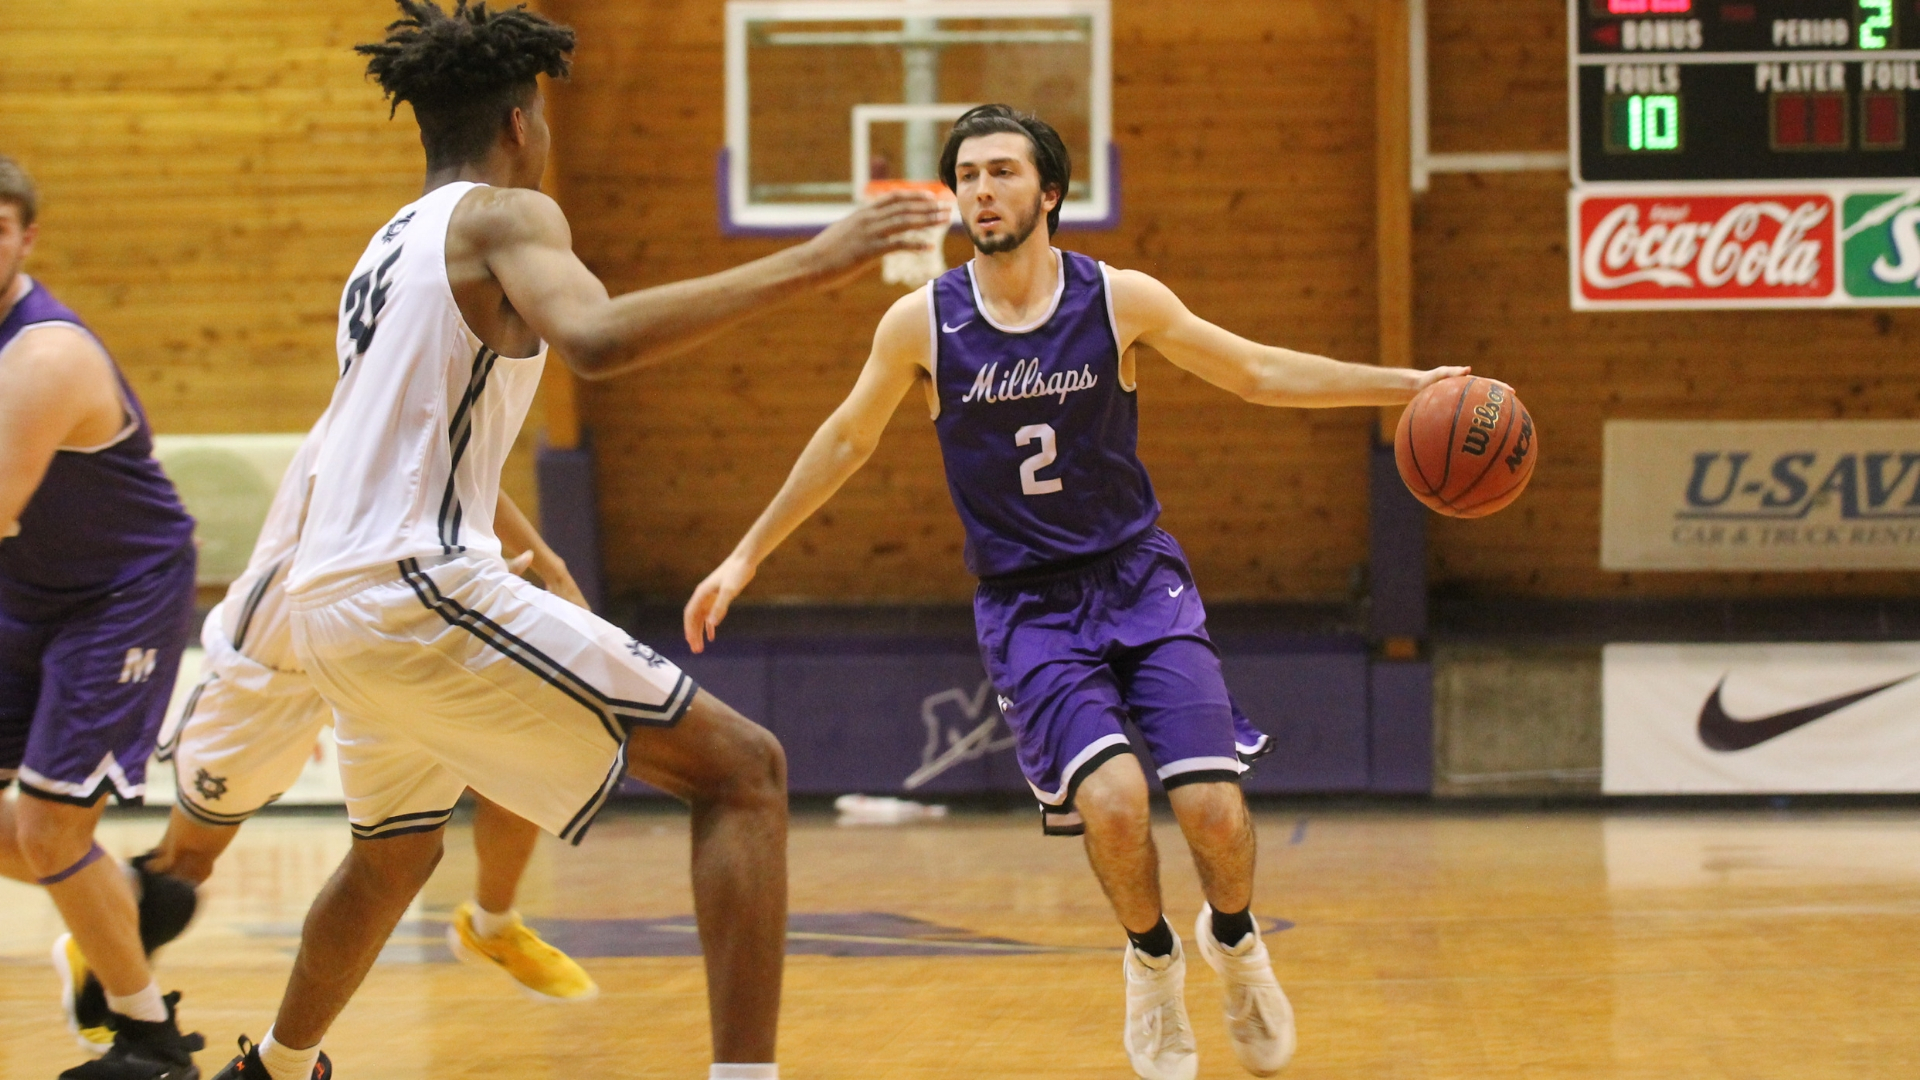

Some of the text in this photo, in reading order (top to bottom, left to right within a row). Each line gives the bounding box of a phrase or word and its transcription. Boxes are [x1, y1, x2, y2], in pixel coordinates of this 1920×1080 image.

[1622, 19, 1702, 49] BONUS
[1772, 0, 1892, 48] PERIOD 2
[1604, 63, 1680, 92] FOULS
[1756, 61, 1846, 92] PLAYER
[1628, 95, 1678, 150] 10
[1583, 201, 1829, 289] Coca-Cola
[962, 357, 1098, 405] Millsaps
[1461, 382, 1505, 457] Wilson
[1014, 422, 1064, 496] 2
[1672, 525, 1725, 545] CAR
